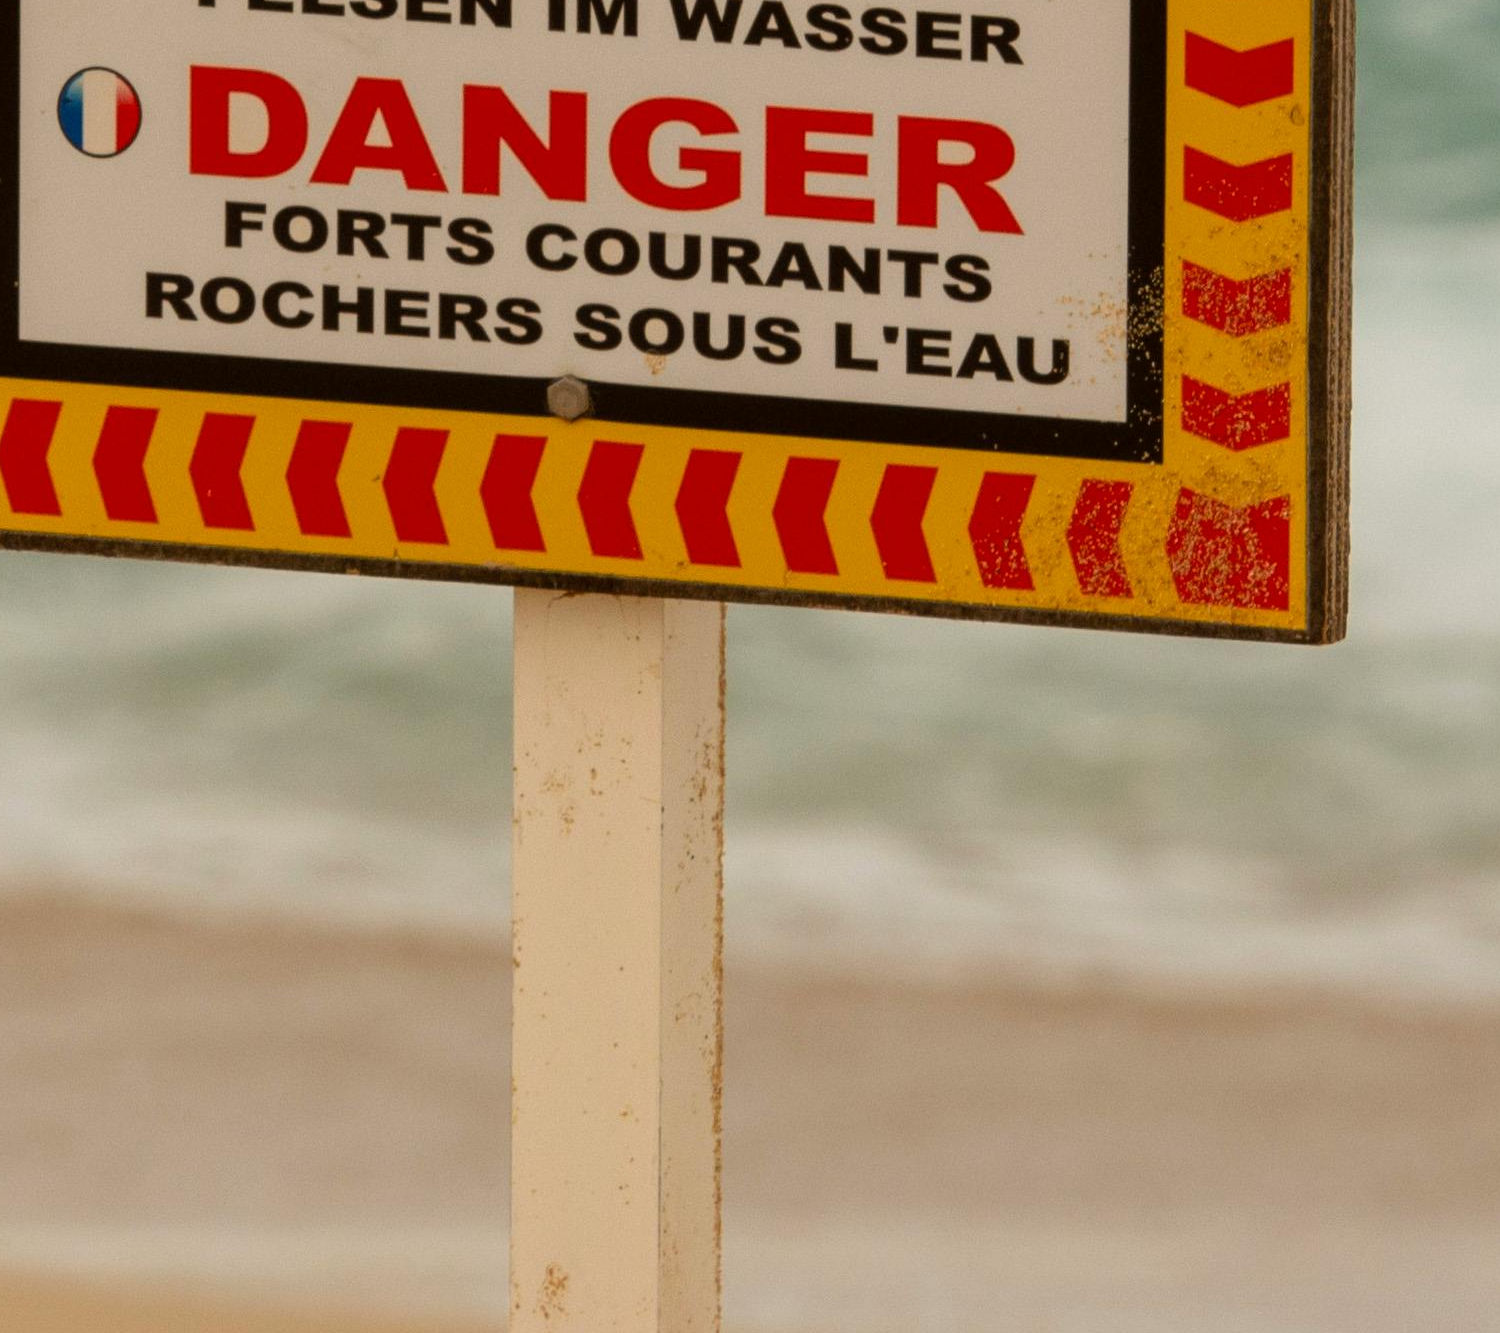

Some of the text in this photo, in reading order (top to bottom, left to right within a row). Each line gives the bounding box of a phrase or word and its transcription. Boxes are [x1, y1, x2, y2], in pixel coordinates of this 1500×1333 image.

[187, 63, 1025, 236] DANGER
[225, 201, 992, 303] FORTS COURANTS
[146, 272, 1070, 386] ROCHERS SOUS L'EAU
